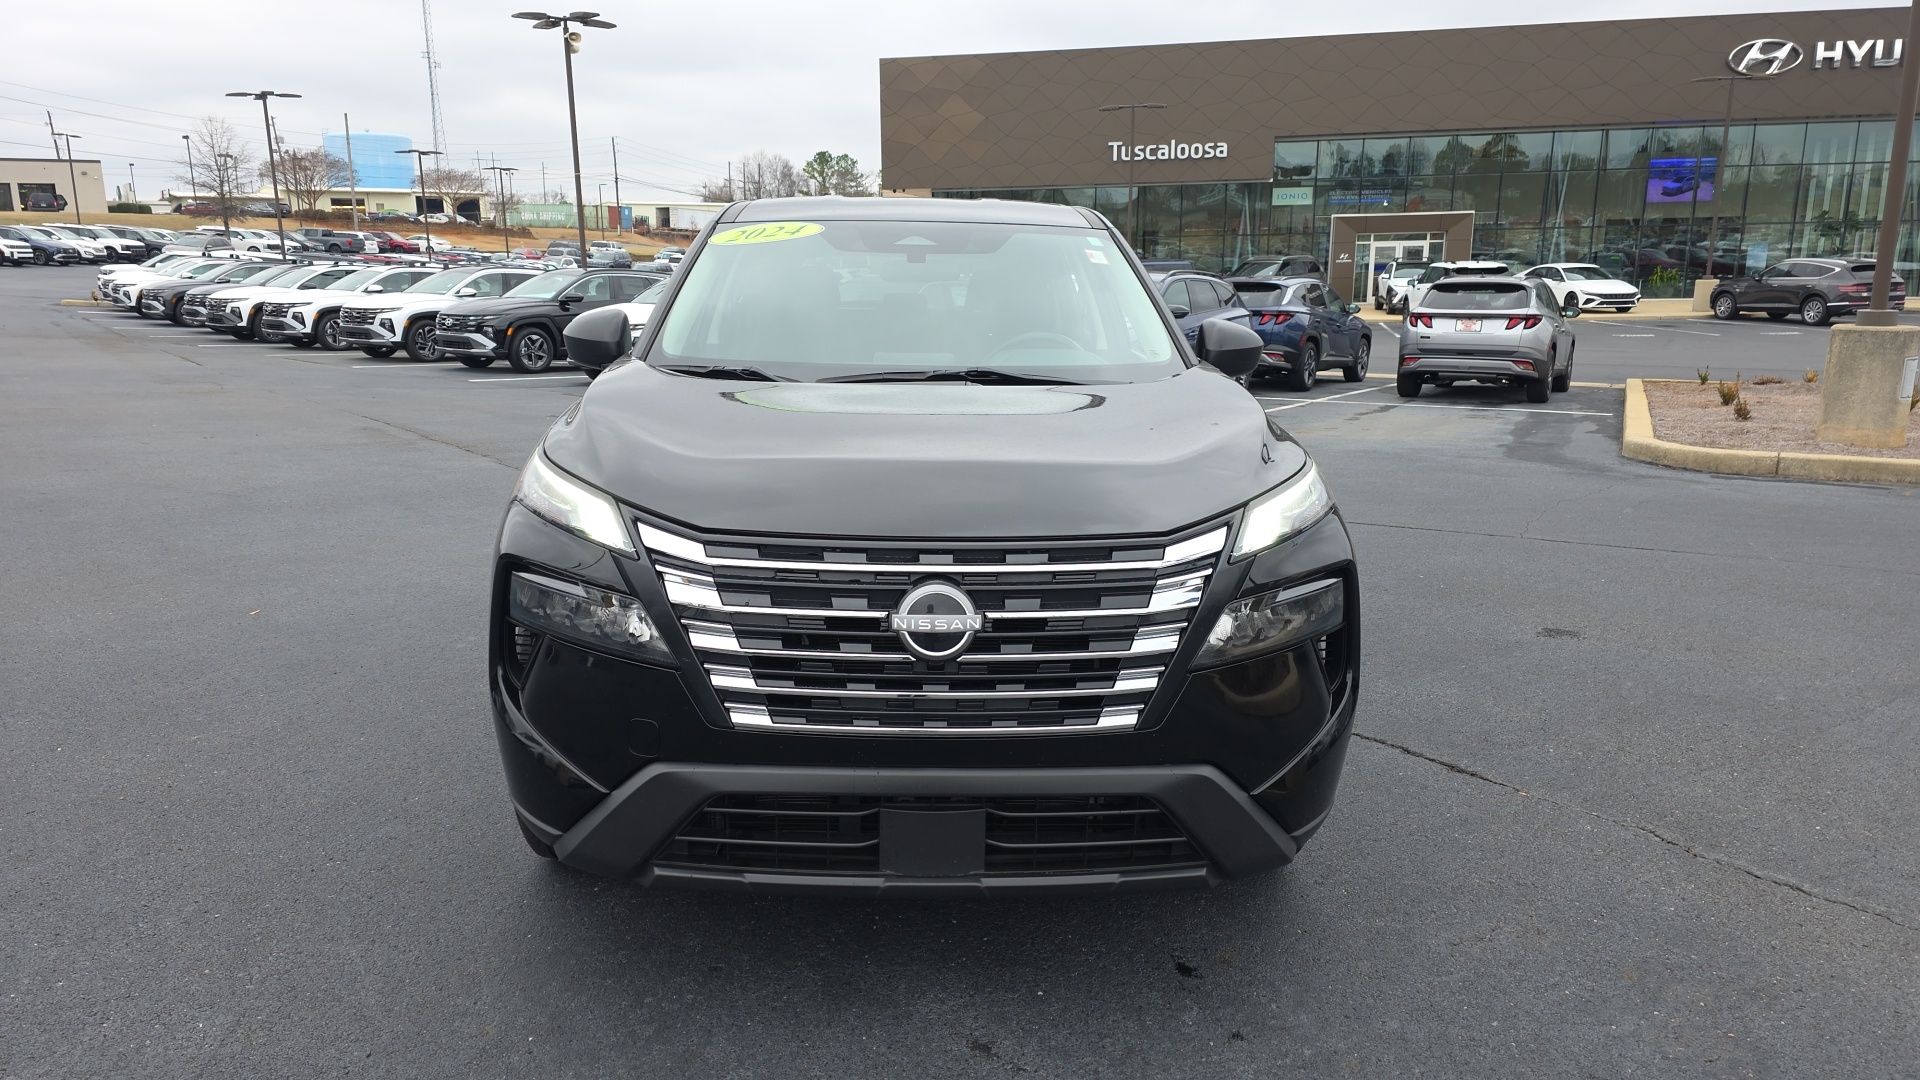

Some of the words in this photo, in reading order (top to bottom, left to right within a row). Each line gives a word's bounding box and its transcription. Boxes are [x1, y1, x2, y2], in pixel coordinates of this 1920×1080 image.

[1108, 139, 1228, 161] Tuscaloosa
[539, 211, 565, 220] SHIPPING
[724, 225, 808, 242] 2024
[894, 618, 980, 630] NISSAN
